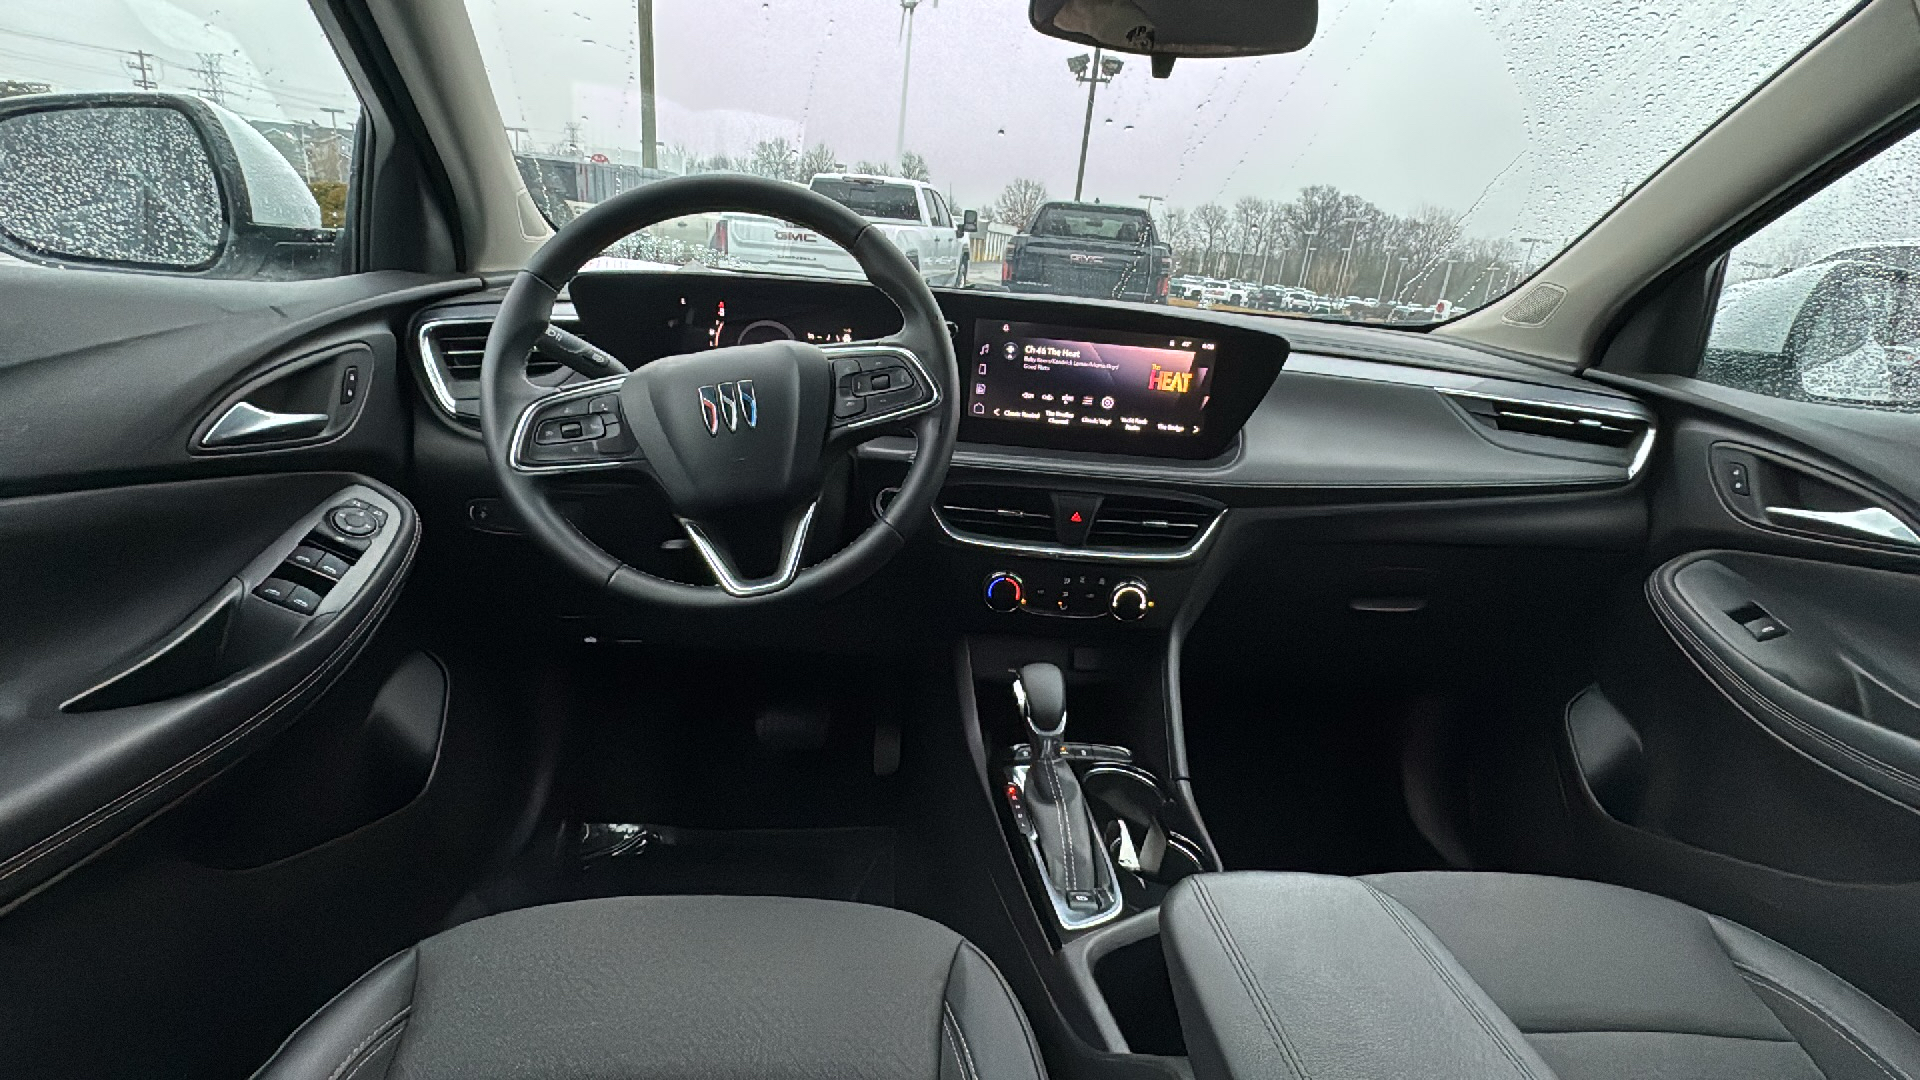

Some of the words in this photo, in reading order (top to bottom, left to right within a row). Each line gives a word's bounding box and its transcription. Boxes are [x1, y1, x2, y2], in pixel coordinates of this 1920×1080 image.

[775, 231, 817, 242] GMC
[1070, 253, 1104, 264] GMC
[1024, 345, 1036, 354] Ch
[1047, 347, 1061, 357] The
[1062, 349, 1080, 358] Heat
[1151, 363, 1161, 371] The
[1148, 369, 1193, 393] HEAT
